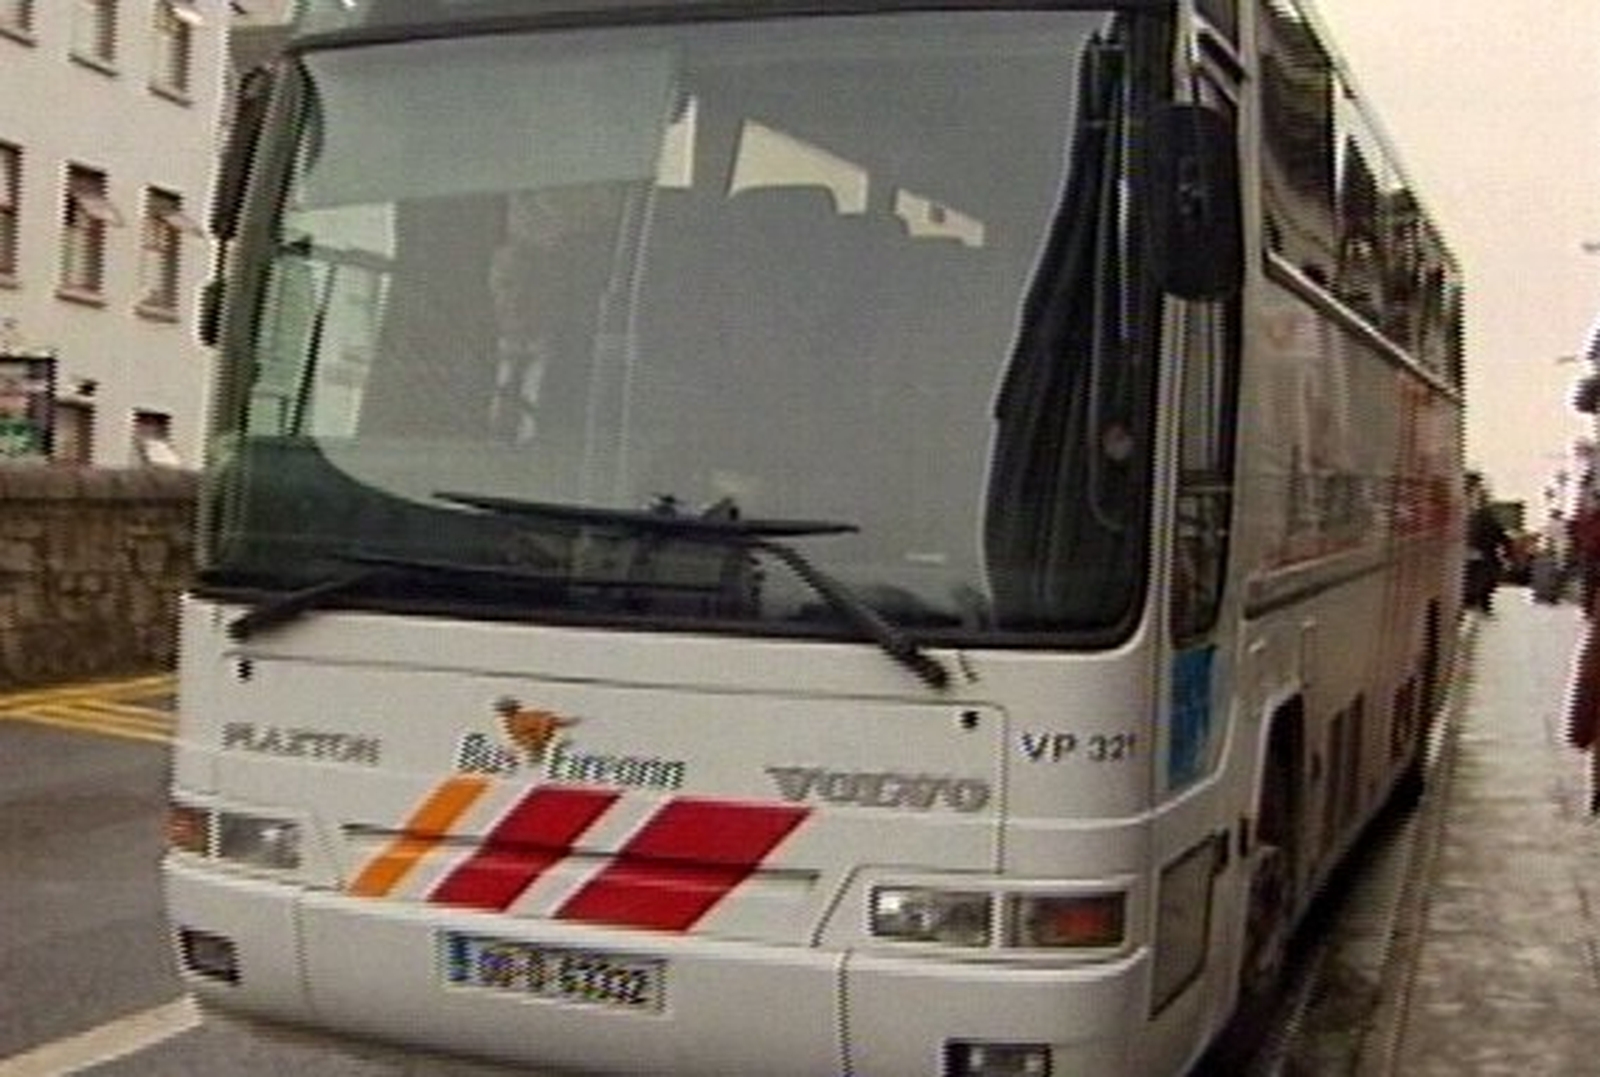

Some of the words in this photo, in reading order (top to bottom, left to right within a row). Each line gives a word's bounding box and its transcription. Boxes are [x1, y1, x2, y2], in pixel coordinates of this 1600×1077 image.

[458, 733, 519, 774] Bus
[1020, 732, 1077, 763] VP
[764, 768, 990, 813] VOLVO
